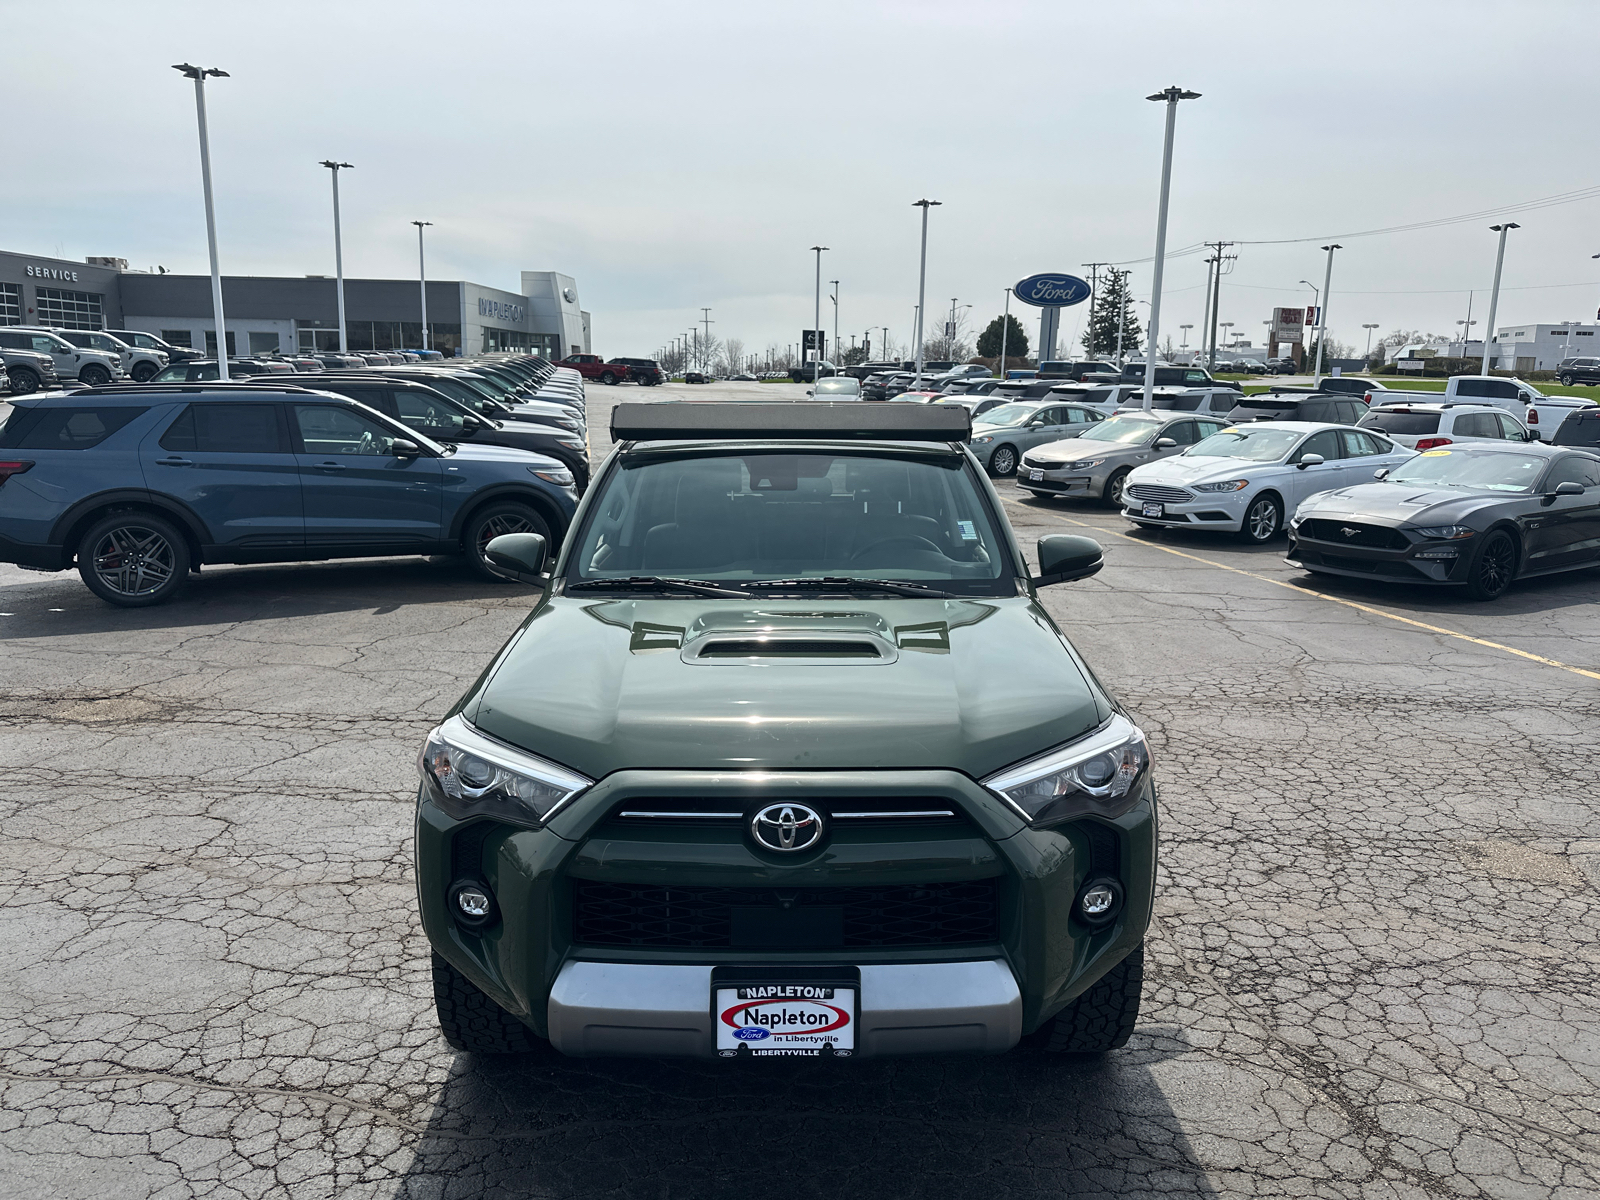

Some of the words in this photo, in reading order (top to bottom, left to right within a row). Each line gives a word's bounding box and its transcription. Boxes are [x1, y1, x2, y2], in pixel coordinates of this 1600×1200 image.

[26, 265, 78, 282] SERVICE
[1031, 279, 1077, 300] Ford
[478, 297, 524, 323] NAPLETON
[745, 986, 826, 999] NAPLETON
[744, 1008, 829, 1029] Napleton
[740, 1029, 763, 1039] Ford
[785, 1035, 839, 1043] Libertyville
